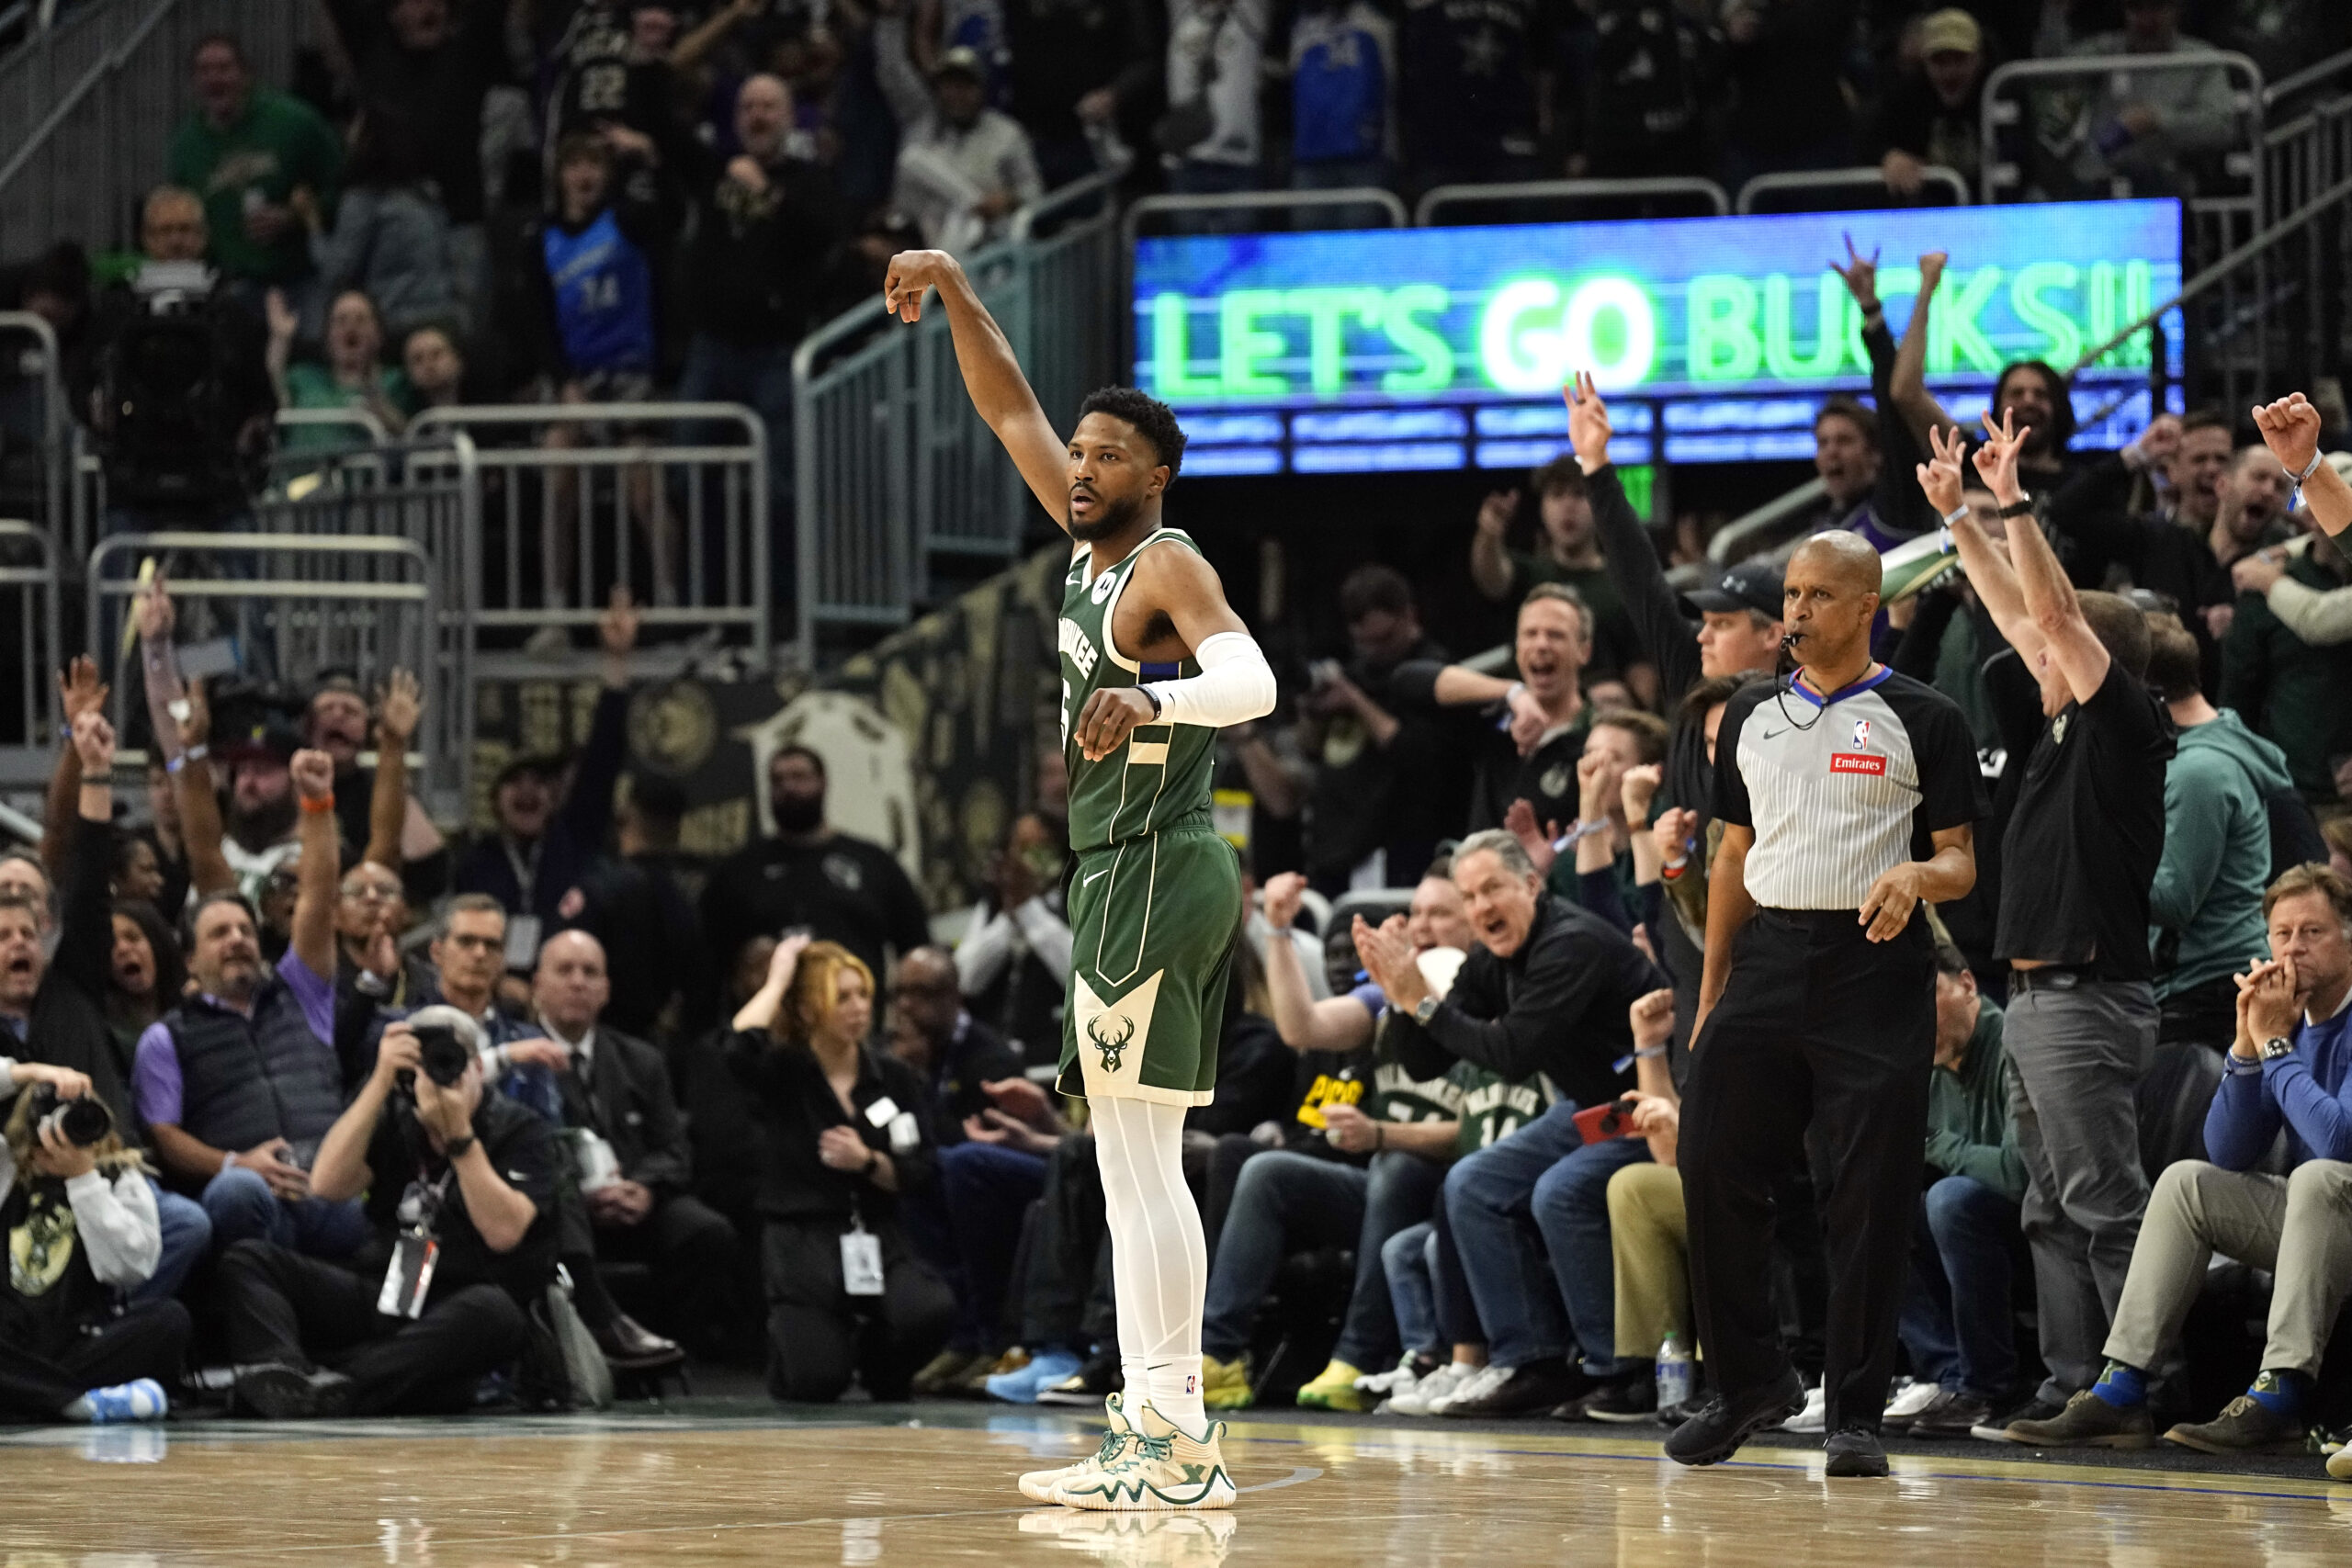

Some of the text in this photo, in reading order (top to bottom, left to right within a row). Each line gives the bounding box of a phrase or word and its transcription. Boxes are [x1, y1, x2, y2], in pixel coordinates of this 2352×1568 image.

[1153, 283, 1456, 399] LET'S
[1481, 276, 1655, 393] GO
[1836, 757, 1880, 771] Emirates
